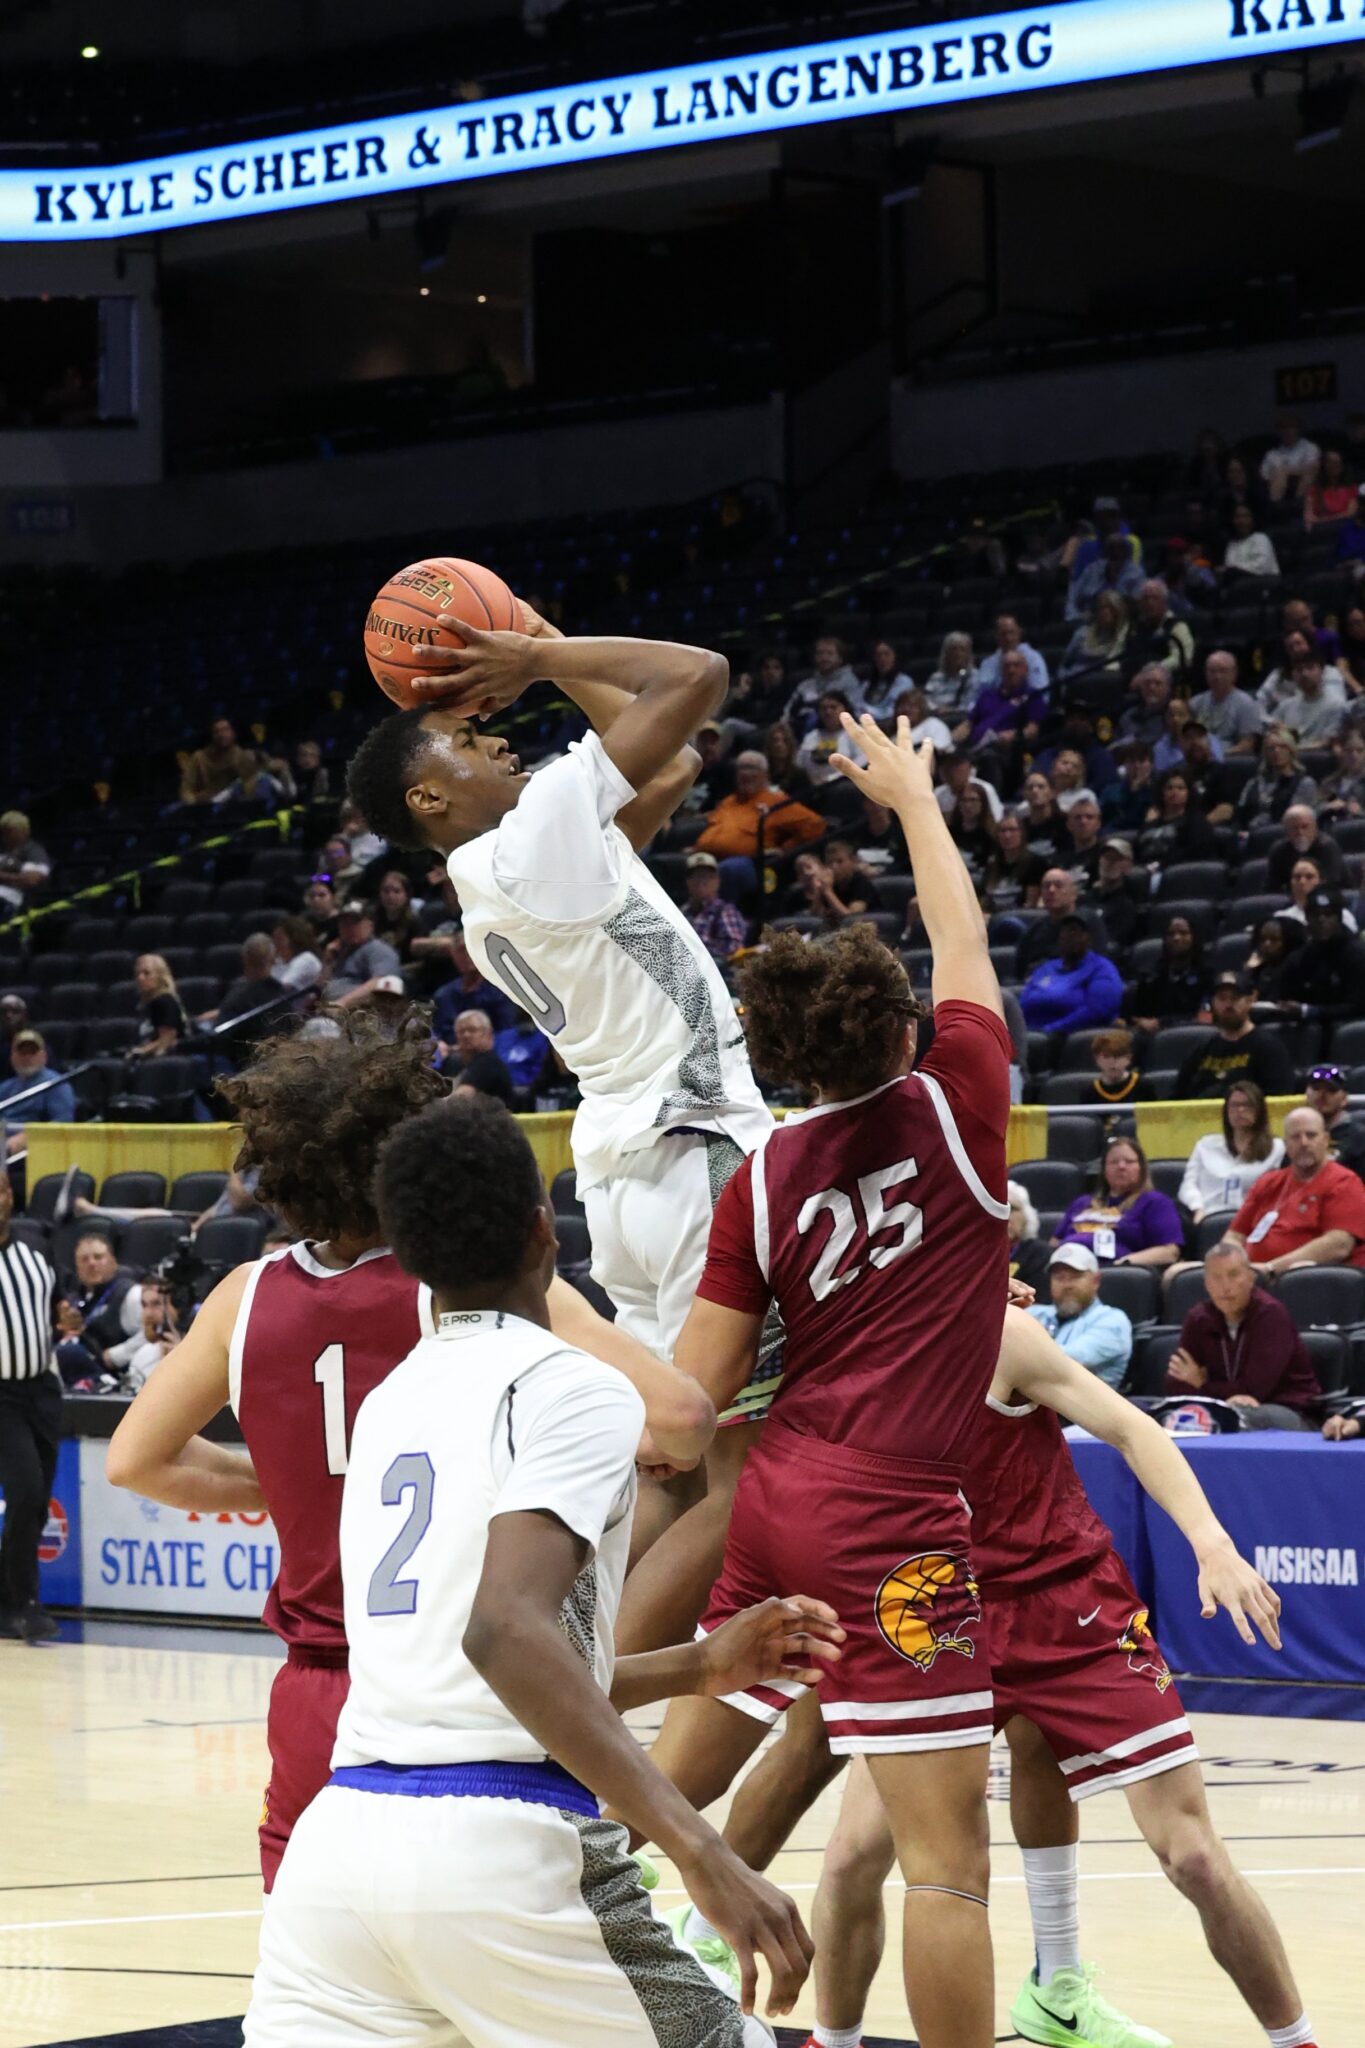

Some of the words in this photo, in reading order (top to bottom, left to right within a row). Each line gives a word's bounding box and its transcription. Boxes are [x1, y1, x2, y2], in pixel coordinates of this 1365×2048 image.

[34, 171, 175, 223] KYLE
[194, 135, 388, 206] SCHEER
[407, 126, 441, 170] &
[457, 94, 632, 160] TRACY
[651, 23, 1053, 129] LANGENBERG
[365, 608, 440, 646] SPALDIN
[390, 574, 454, 609] LEGAC
[484, 931, 566, 1036] 0
[797, 1157, 923, 1302] 25
[451, 1313, 482, 1325] PRO
[314, 1343, 350, 1476] 1
[101, 1537, 207, 1588] STATE
[223, 1542, 275, 1591] CH
[367, 1452, 435, 1616] 2
[1254, 1545, 1360, 1587] MSHSAA
